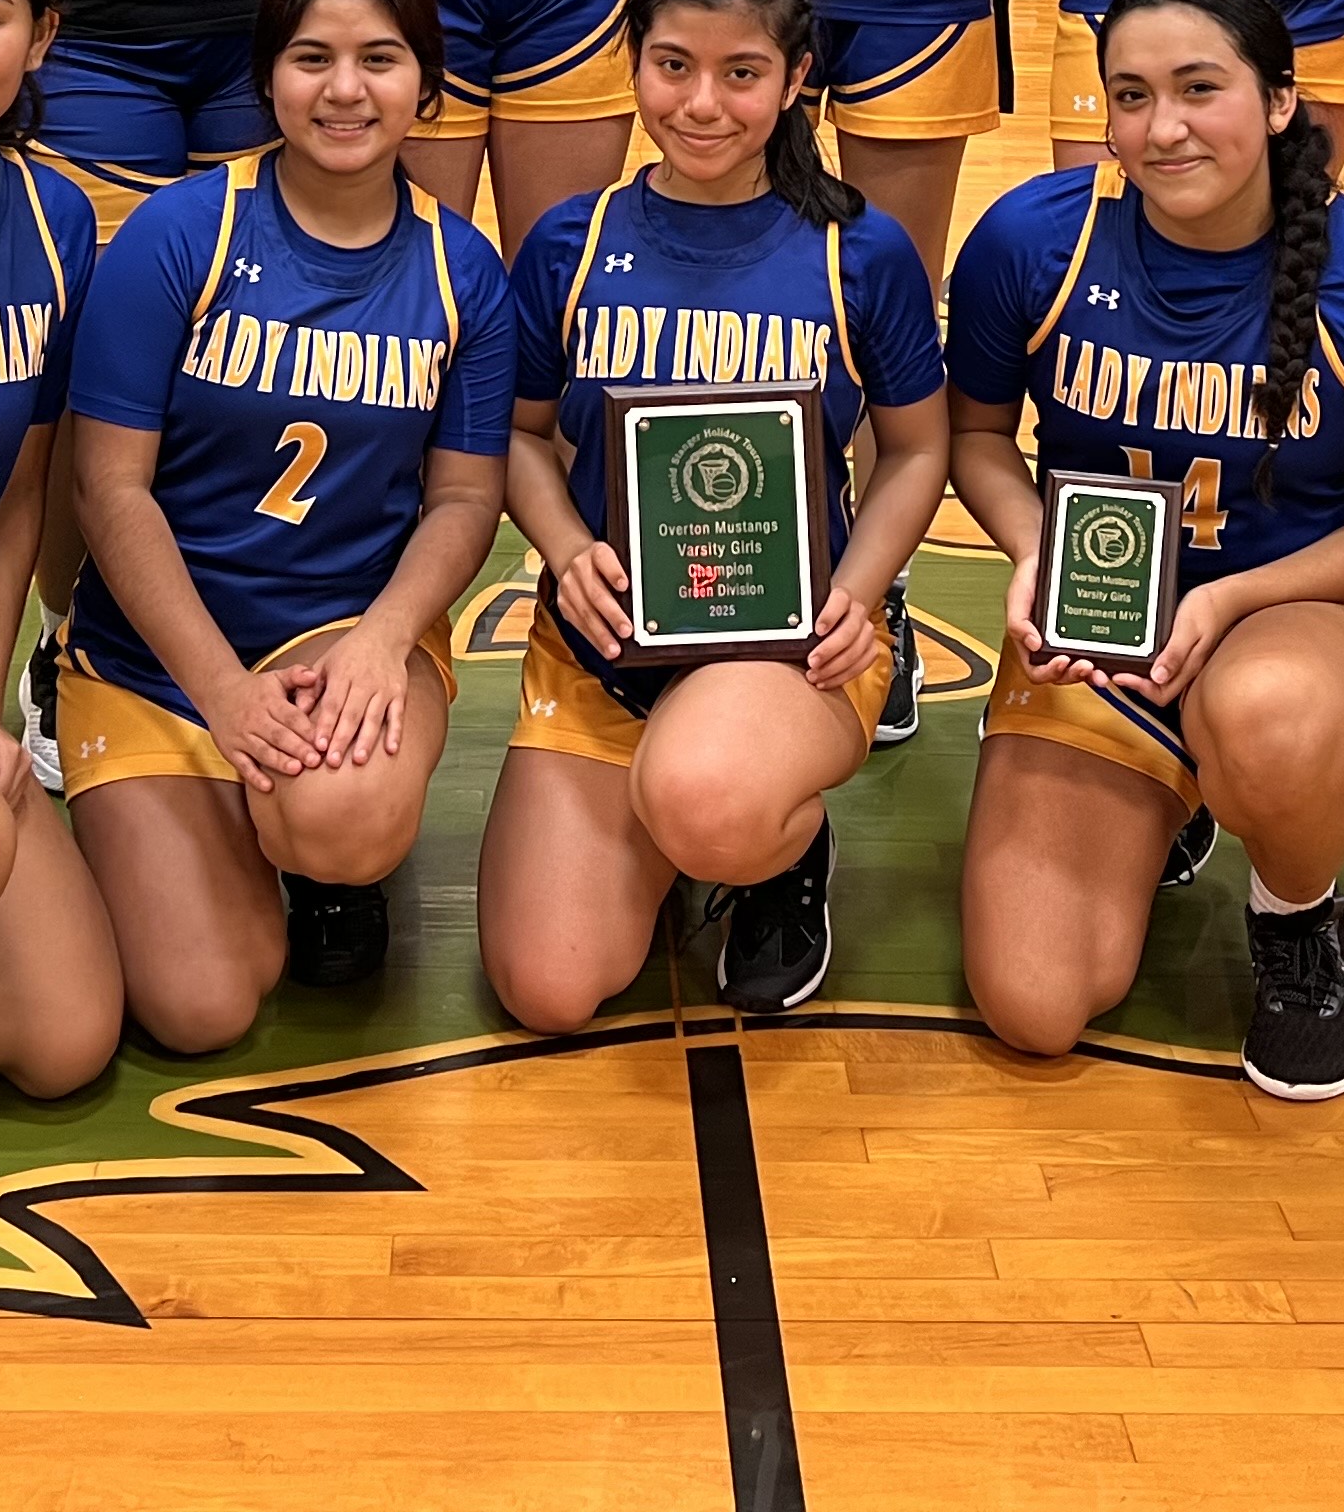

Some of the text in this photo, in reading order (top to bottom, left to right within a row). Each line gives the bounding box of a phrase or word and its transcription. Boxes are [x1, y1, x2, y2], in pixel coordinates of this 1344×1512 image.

[575, 305, 832, 393] LADY INDIANS
[181, 309, 447, 411] LADY INDIANS
[1052, 333, 1152, 426] LADY
[703, 427, 743, 443] Holiday
[742, 437, 765, 499] Tournament
[253, 421, 328, 525] 2
[658, 520, 779, 537] Overton Mustangs
[676, 539, 763, 558] Varsity Girls
[687, 561, 754, 579] Champion
[1069, 571, 1101, 584] Overton
[678, 582, 765, 599] Green Division
[1076, 587, 1132, 604] Varsity Girls
[708, 604, 737, 617] 2025
[1062, 603, 1143, 622] Tournament MVP
